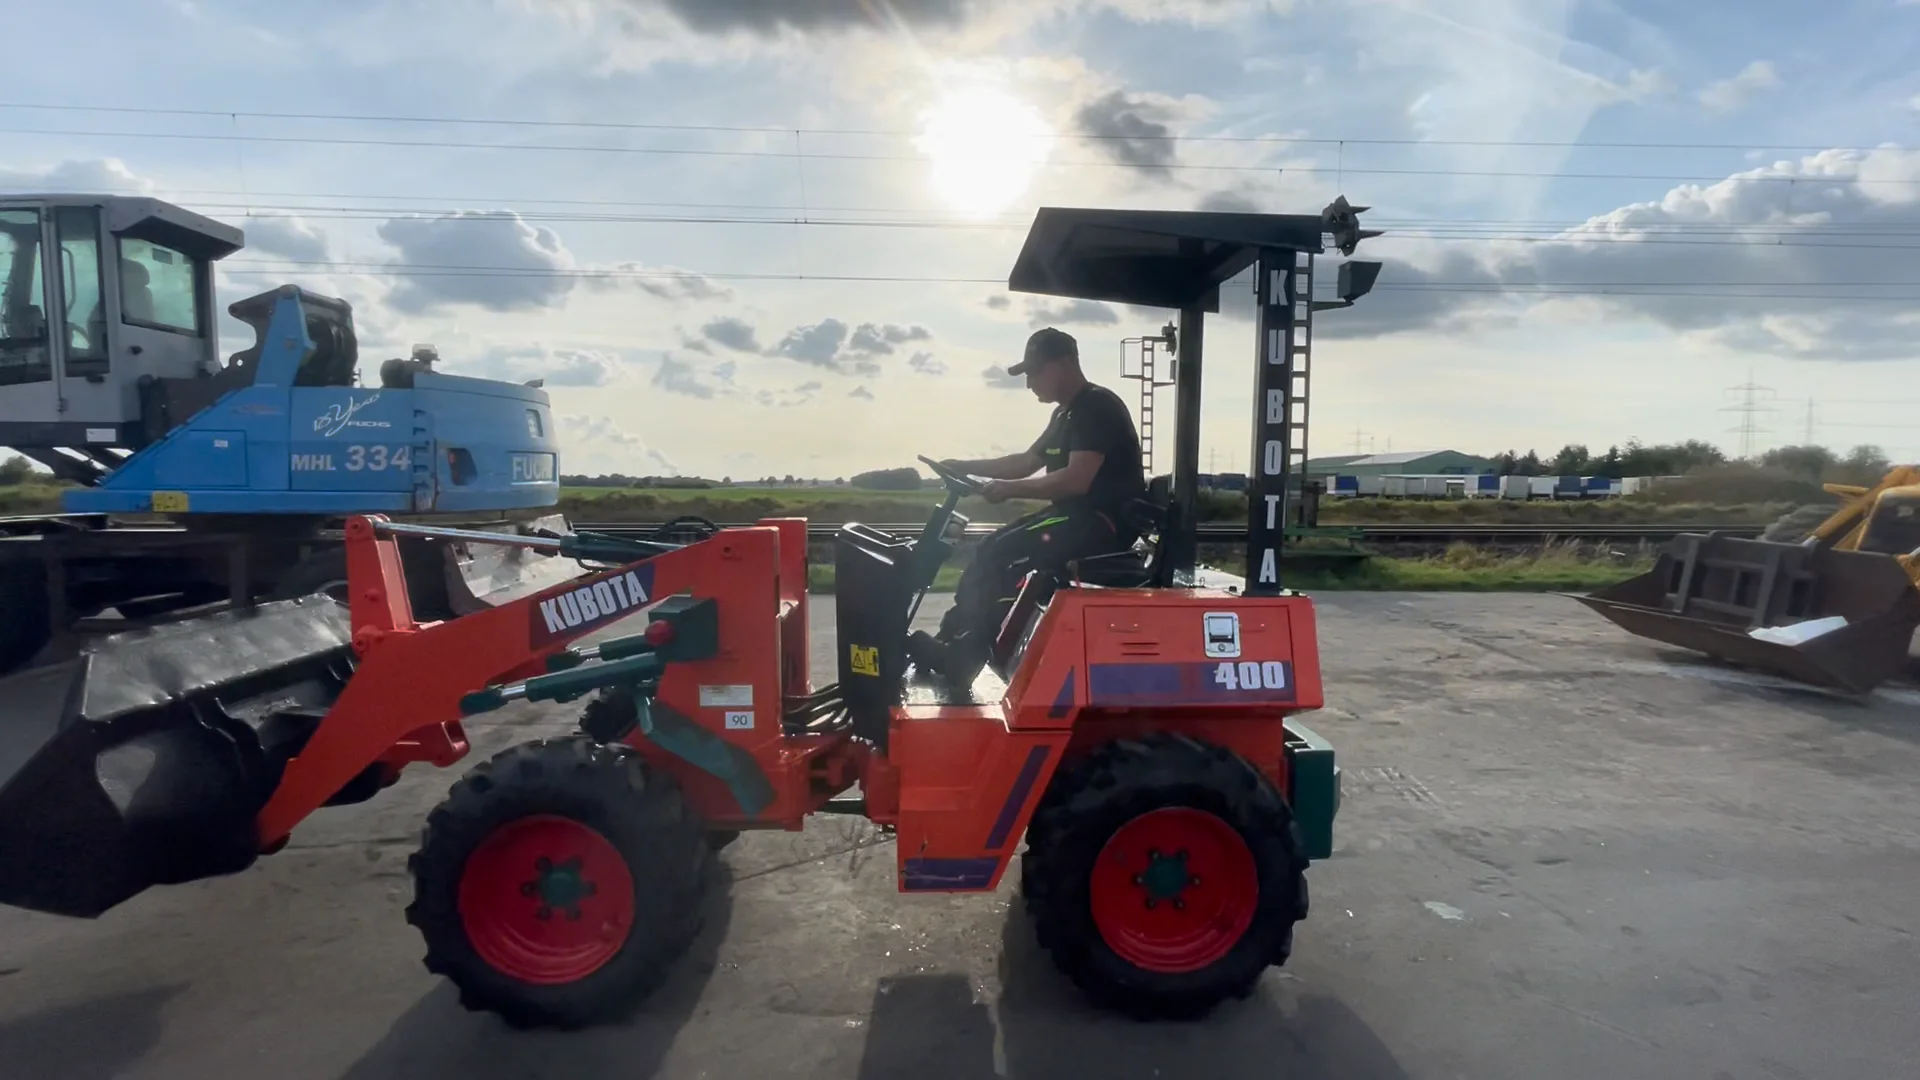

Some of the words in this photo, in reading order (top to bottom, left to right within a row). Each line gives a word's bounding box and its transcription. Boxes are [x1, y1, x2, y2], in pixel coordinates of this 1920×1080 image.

[1258, 269, 1289, 583] KUBOTA
[291, 454, 336, 471] MHL
[345, 445, 411, 471] 334
[540, 571, 648, 634] KUBOTA
[1213, 661, 1285, 690] 400
[732, 714, 748, 726] 90
